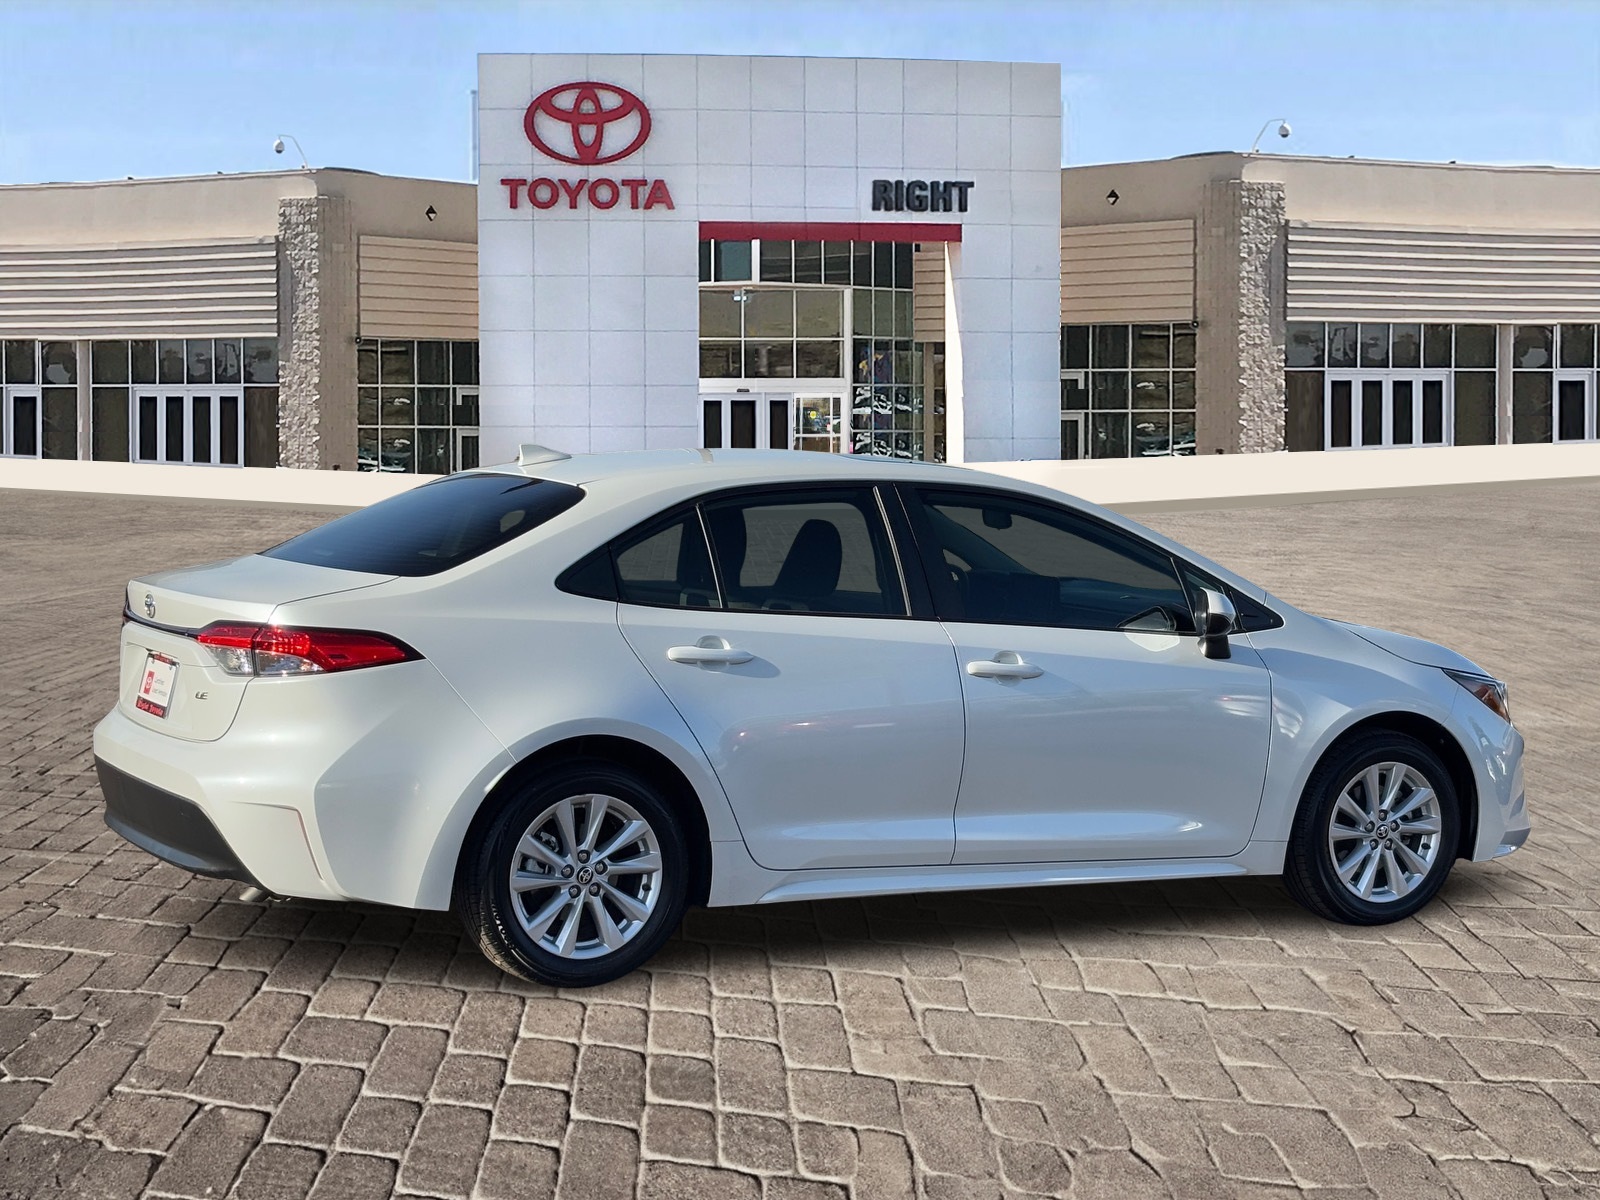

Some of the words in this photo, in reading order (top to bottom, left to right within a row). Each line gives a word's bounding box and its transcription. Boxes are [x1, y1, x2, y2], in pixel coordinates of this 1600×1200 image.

[500, 177, 675, 210] TOYOTA
[872, 180, 975, 212] RIGHT
[195, 691, 208, 700] LE
